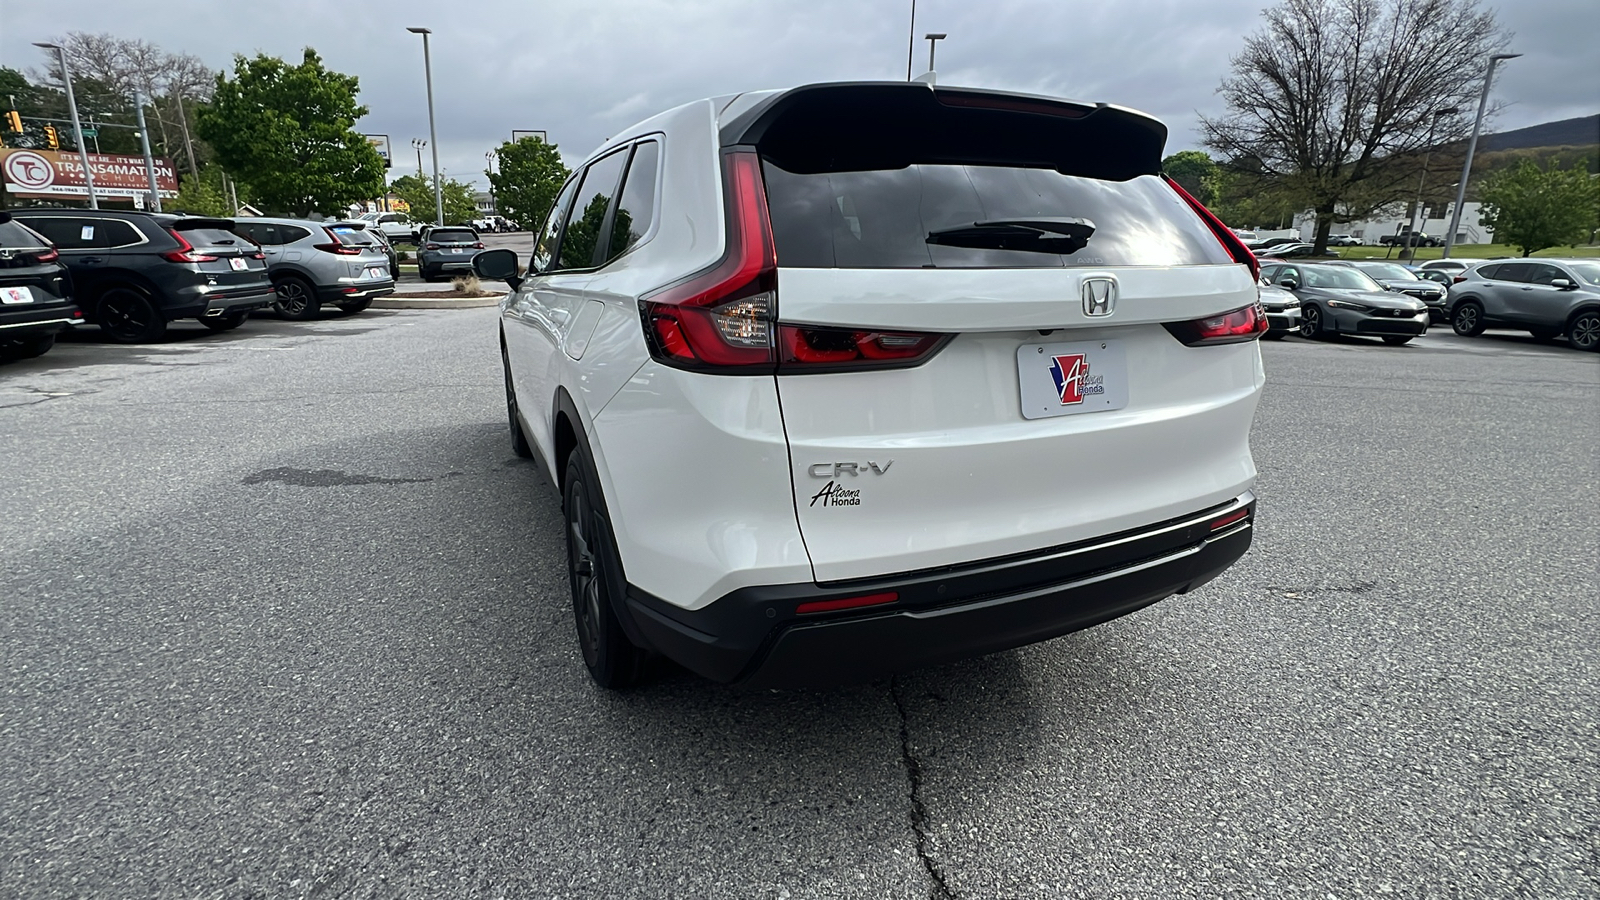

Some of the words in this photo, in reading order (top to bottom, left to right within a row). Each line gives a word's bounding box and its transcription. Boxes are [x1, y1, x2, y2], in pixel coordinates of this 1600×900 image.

[55, 161, 173, 178] TRANS4MATION
[1078, 384, 1104, 395] Honda
[808, 459, 895, 478] CR-V
[809, 480, 861, 508] Altoona
[831, 497, 861, 507] Honda
